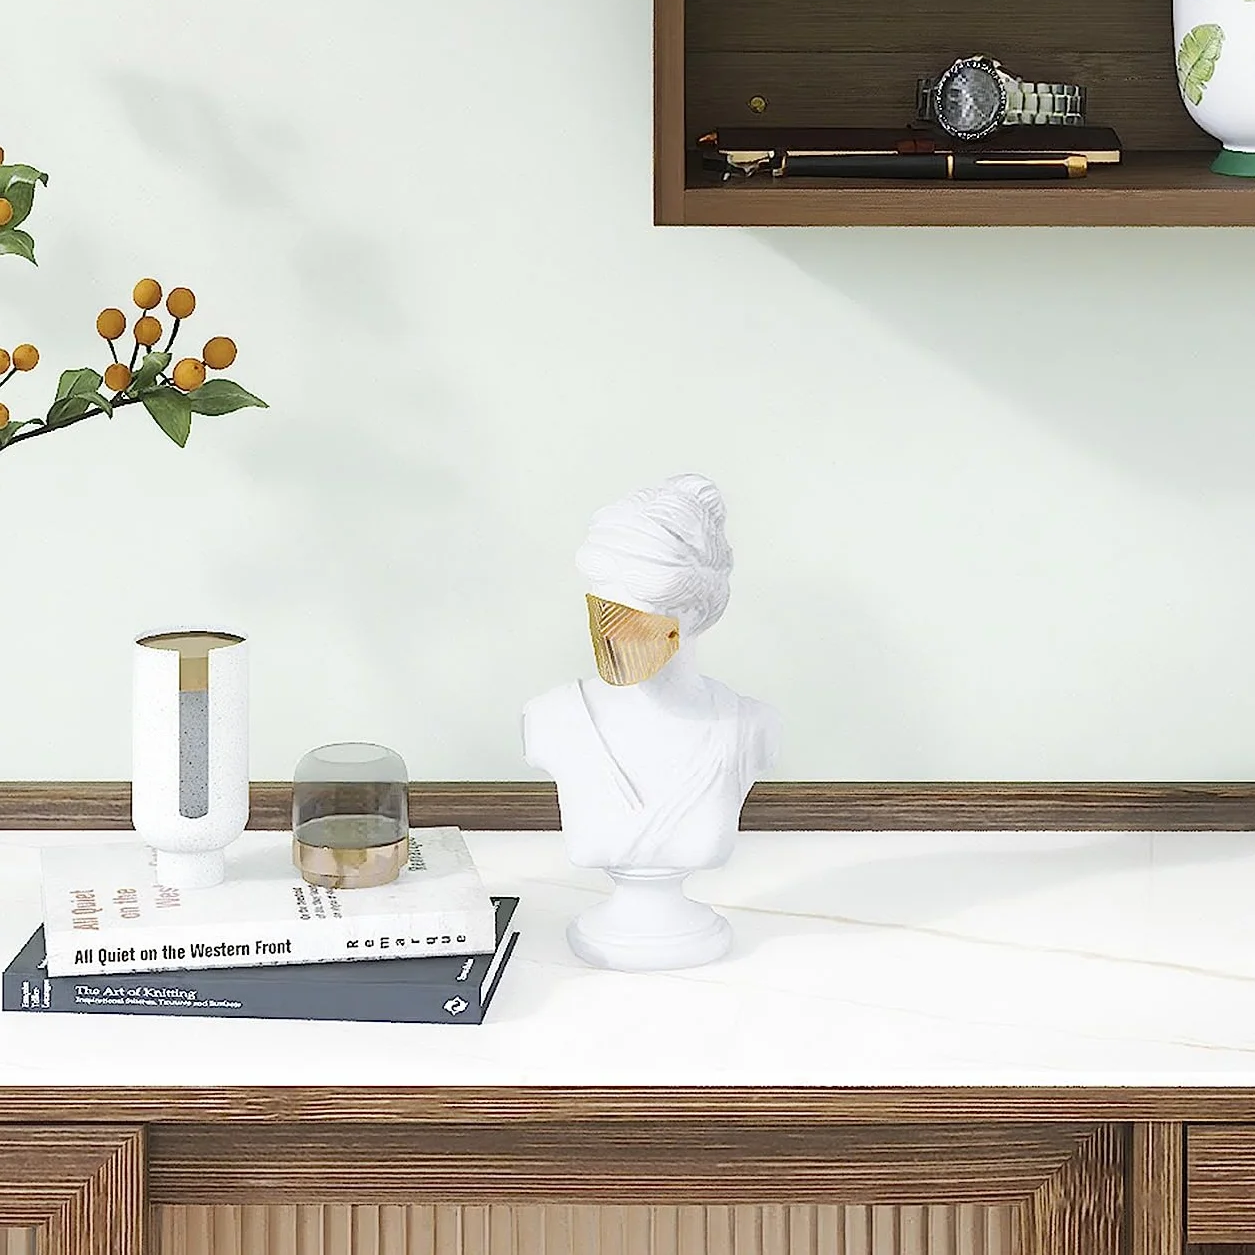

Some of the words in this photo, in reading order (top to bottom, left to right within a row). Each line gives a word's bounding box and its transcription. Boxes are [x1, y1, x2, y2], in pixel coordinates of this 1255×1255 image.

[69, 889, 103, 915] Quiet
[112, 888, 138, 904] the
[120, 906, 140, 919] on
[346, 934, 466, 949] Remarque
[74, 949, 93, 964] All
[98, 947, 136, 966] Quiet
[140, 948, 157, 961] on
[162, 945, 185, 960] the
[190, 943, 250, 959] Western
[256, 939, 292, 955] Front
[74, 985, 100, 995] The
[102, 986, 126, 997] Art
[127, 986, 142, 997] of
[143, 987, 197, 1000] Knitting
